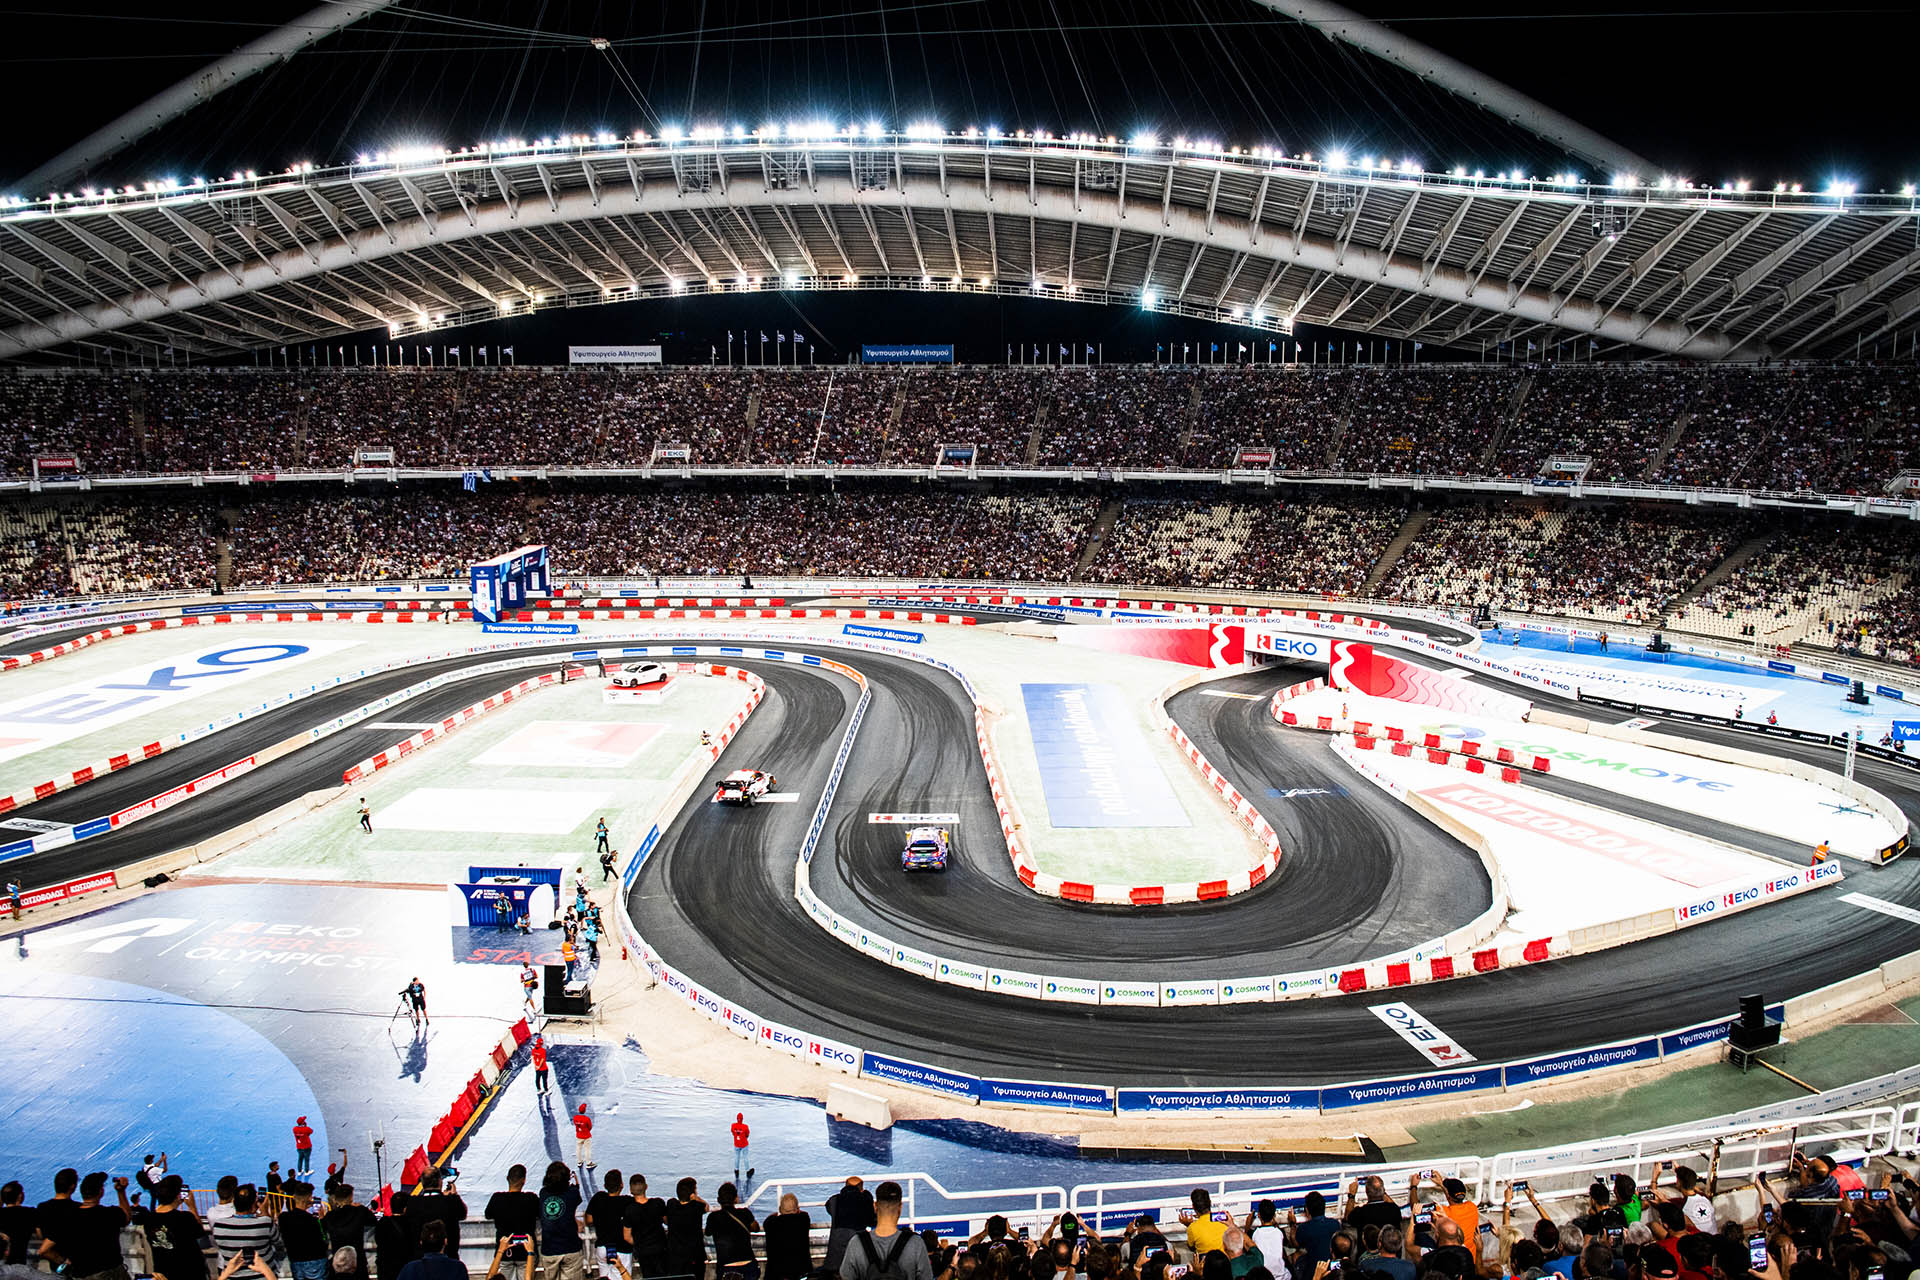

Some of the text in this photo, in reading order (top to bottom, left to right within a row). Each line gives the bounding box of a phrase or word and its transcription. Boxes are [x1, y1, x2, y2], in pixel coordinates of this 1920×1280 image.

[573, 350, 657, 359] Υφυπουργείο Αθλητισμού
[866, 349, 949, 358] Υφυπουργείο Αθλητισμού
[486, 624, 573, 634] Υφυπουργείο Αθλητισμού
[846, 626, 918, 642] Υφυπουργείο Αθλητισμού
[1320, 622, 1336, 630] EKO
[1372, 630, 1390, 638] EKO
[1576, 630, 1594, 638] EKO
[1274, 637, 1318, 656] EKO
[1408, 637, 1425, 647] EKO
[1435, 646, 1452, 655] EKO
[1463, 654, 1481, 664] EKO
[1491, 662, 1510, 674] EKO
[1520, 672, 1540, 683] EKO
[1551, 680, 1571, 692] EKO
[1493, 738, 1736, 793] COSMOTE
[1814, 863, 1838, 879] EKO
[70, 876, 113, 892] ΚΩΤΣΟΒΟΛΟΣ
[1775, 875, 1798, 891] EKO
[1734, 887, 1759, 904] EKO
[1690, 900, 1716, 917] EKO
[264, 924, 364, 938] EKO
[202, 933, 312, 950] SUPER
[185, 946, 345, 966] OLYMPIC
[466, 948, 563, 965] STAG
[905, 954, 933, 970] COSMOTE
[950, 966, 983, 981] COSMOTE
[668, 974, 687, 994] EKO
[1002, 976, 1038, 990] COSMOTE
[1058, 985, 1096, 996] COSMOTE
[1234, 984, 1270, 994] COSMOTE
[1289, 978, 1322, 989] COSMOTE
[1117, 989, 1156, 998] COSMOTE
[1177, 988, 1215, 997] COSMOTE
[697, 994, 719, 1014] EKO
[732, 1012, 756, 1033] EKO
[1386, 1007, 1437, 1042] EKO
[774, 1032, 804, 1050] EKO
[1678, 1024, 1726, 1046] Υφυπουργείο
[823, 1046, 856, 1066] EKO
[1528, 1045, 1638, 1076] Υφυπουργείο Αθλητισμού
[874, 1060, 970, 1091] Υφυπουργείο Αθλητισμού
[992, 1085, 1102, 1104] Υφυπουργείο Αθλητισμού
[1349, 1073, 1476, 1100] Υφυπουργείο Αθλητισμού
[1148, 1094, 1290, 1108] Υφυπουργείο Αθλητισμού
[1114, 1210, 1145, 1222] Αθλητισμού
